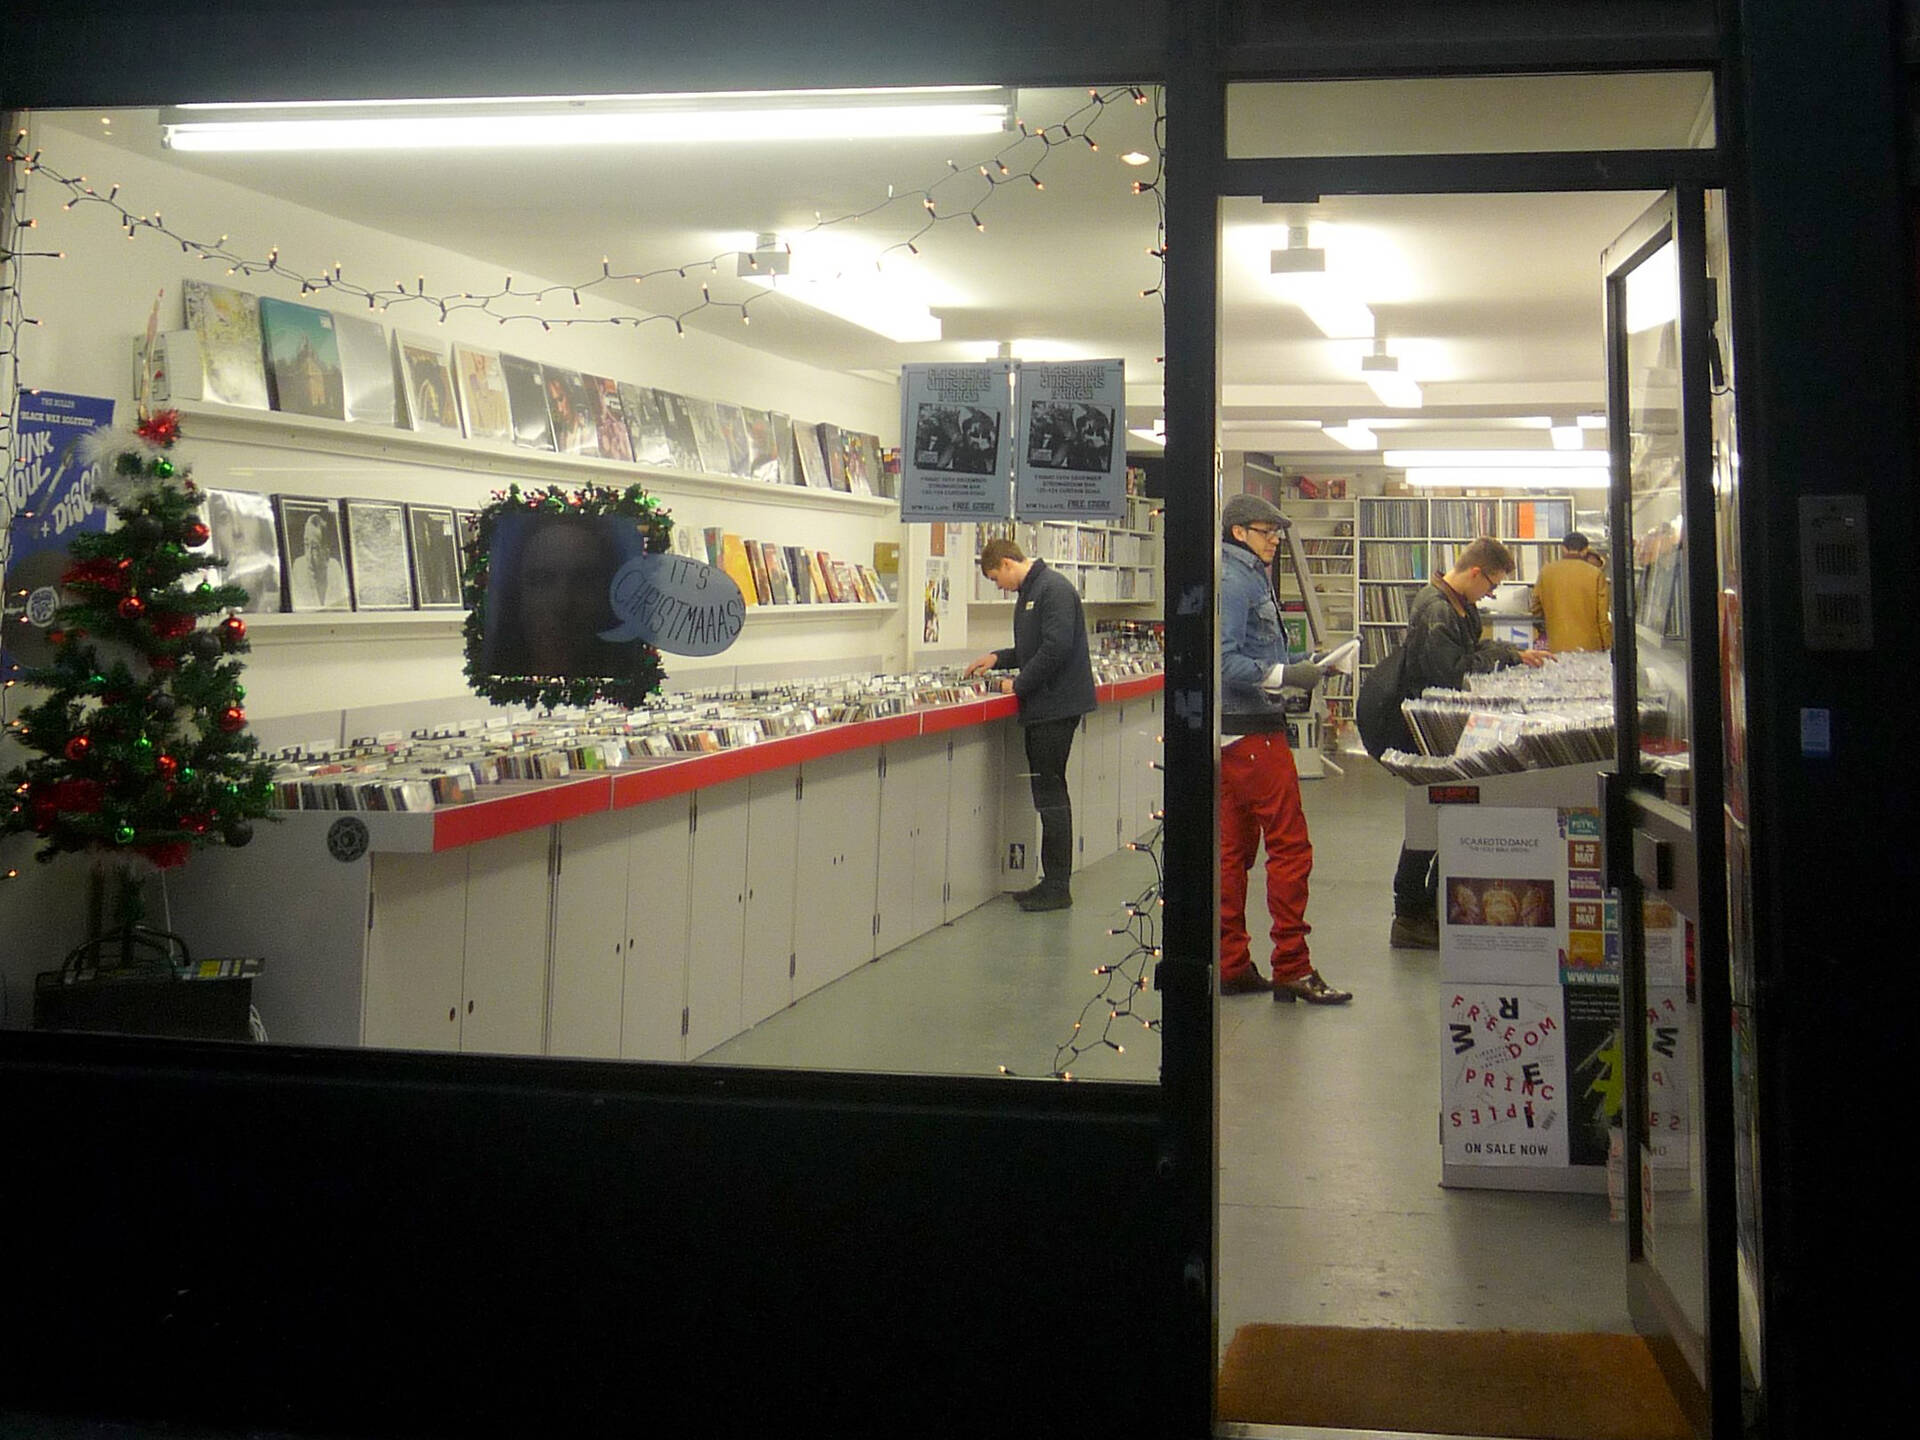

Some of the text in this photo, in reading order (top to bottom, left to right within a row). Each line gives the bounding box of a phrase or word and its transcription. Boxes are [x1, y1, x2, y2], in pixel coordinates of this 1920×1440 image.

[669, 559, 711, 590] IT'S
[1464, 1142, 1548, 1156] ON SALE NOW
